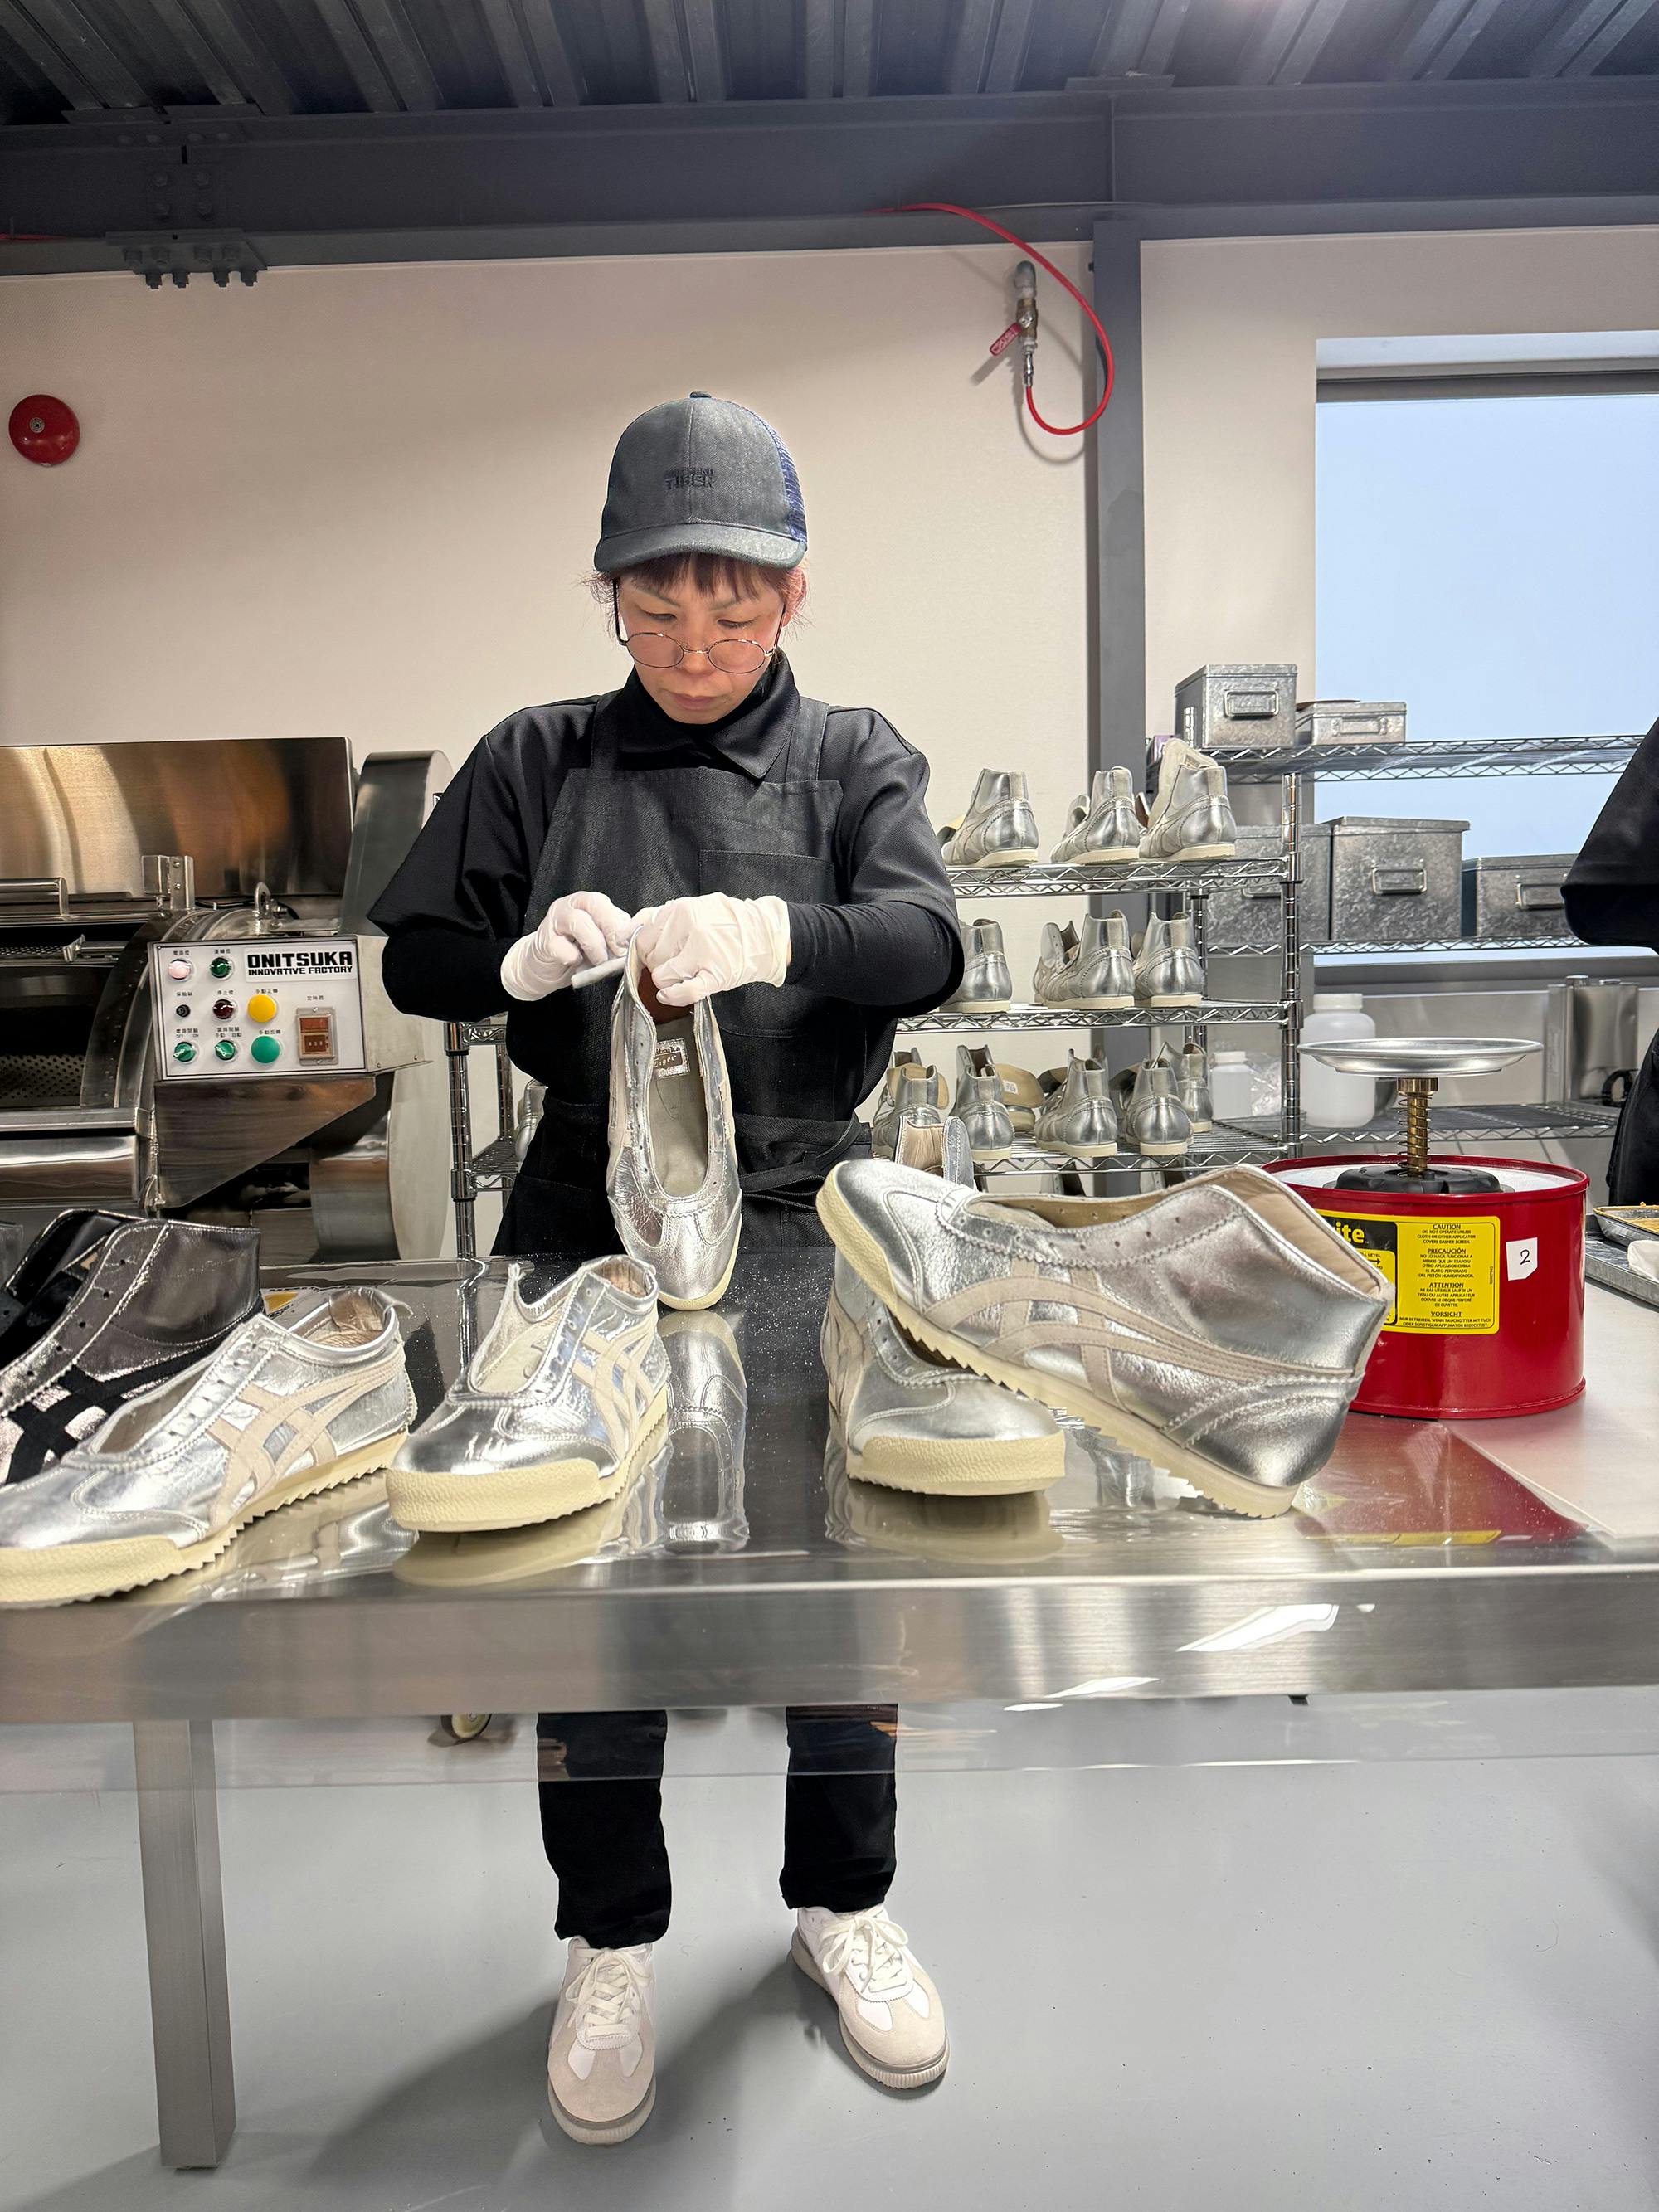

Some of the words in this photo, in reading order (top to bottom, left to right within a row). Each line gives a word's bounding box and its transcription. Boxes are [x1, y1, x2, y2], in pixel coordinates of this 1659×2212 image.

[247, 951, 353, 968] ONITSUKA
[248, 968, 306, 976] INNOVATIVE
[1335, 1222, 1365, 1243] ite
[1520, 1249, 1530, 1265] 2
